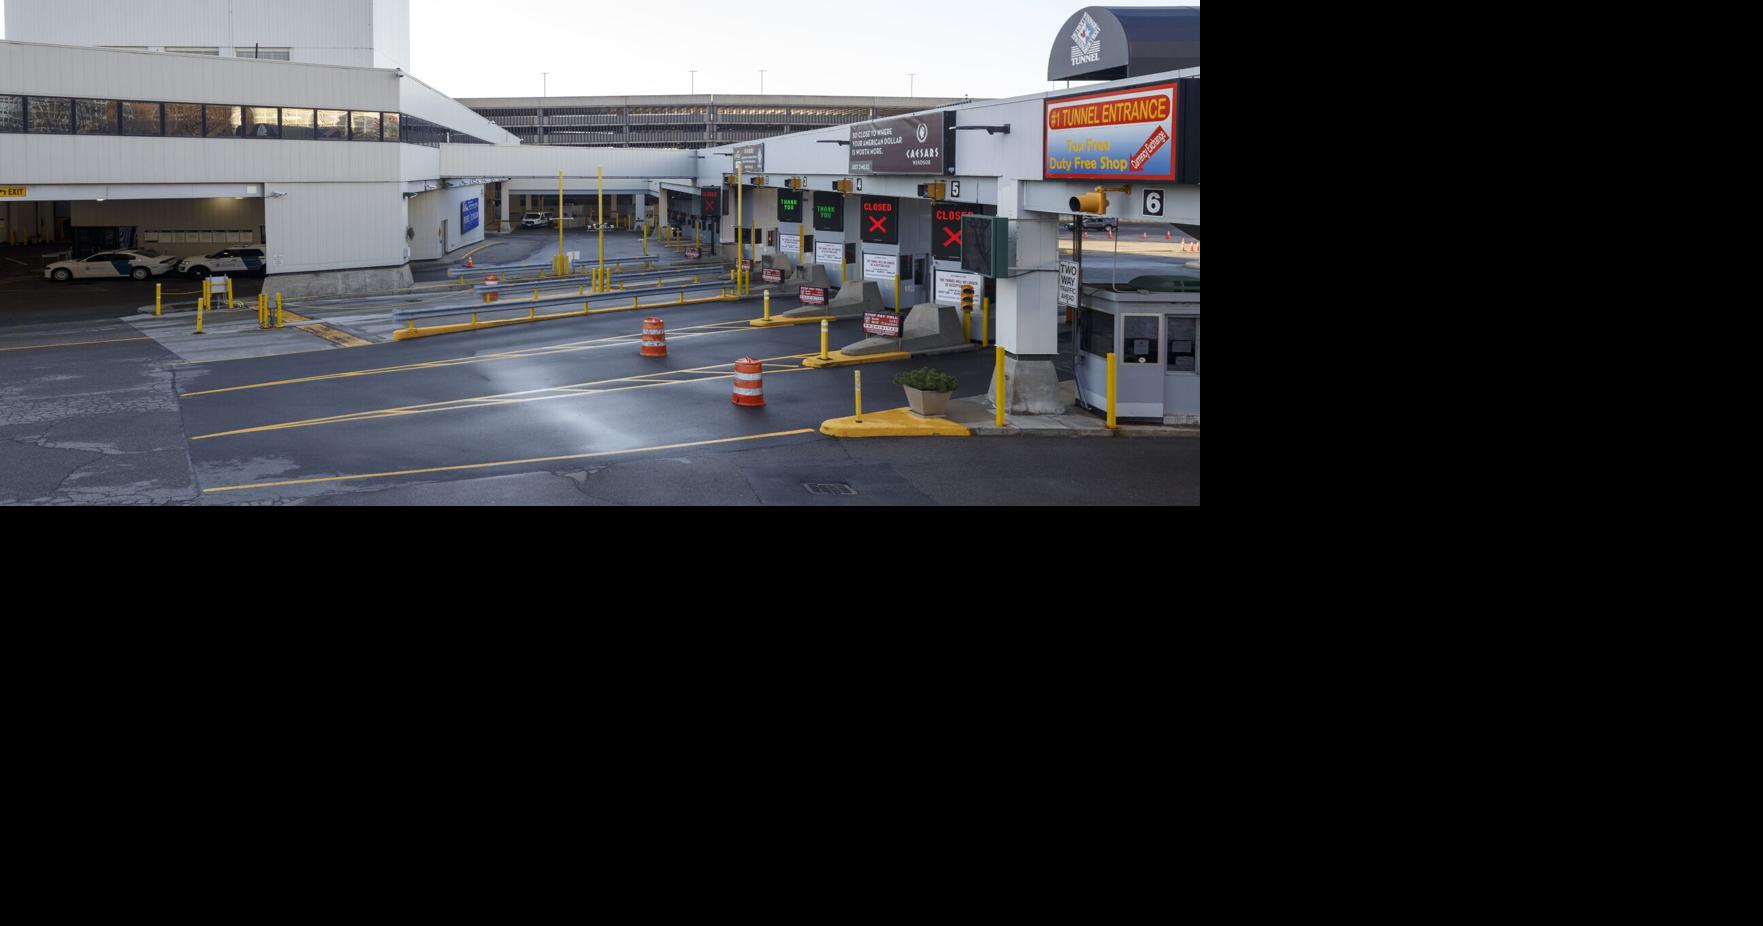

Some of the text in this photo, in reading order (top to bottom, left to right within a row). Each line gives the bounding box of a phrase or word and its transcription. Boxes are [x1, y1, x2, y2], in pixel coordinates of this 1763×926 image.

[1072, 53, 1100, 66] TUNNEL
[1051, 97, 1166, 127] #1 TUNNEL ENTRANCE
[863, 138, 883, 146] AMERICAN
[884, 136, 902, 145] DOLLAR
[1066, 138, 1110, 152] Tax Free
[906, 147, 939, 159] CAESARS
[1130, 130, 1166, 169] Currency Exchange
[1050, 156, 1128, 172] Duty Free Shop
[857, 179, 862, 190] 4
[952, 182, 959, 196] 5
[8, 188, 23, 196] EXIT
[817, 205, 835, 213] THANK
[864, 202, 892, 212] CLOSED
[1146, 192, 1161, 214] 6
[1061, 263, 1076, 276] TWO
[1061, 275, 1075, 287] WAY
[1060, 285, 1076, 295] TRAFFIC
[1061, 292, 1075, 302] AHEAD
